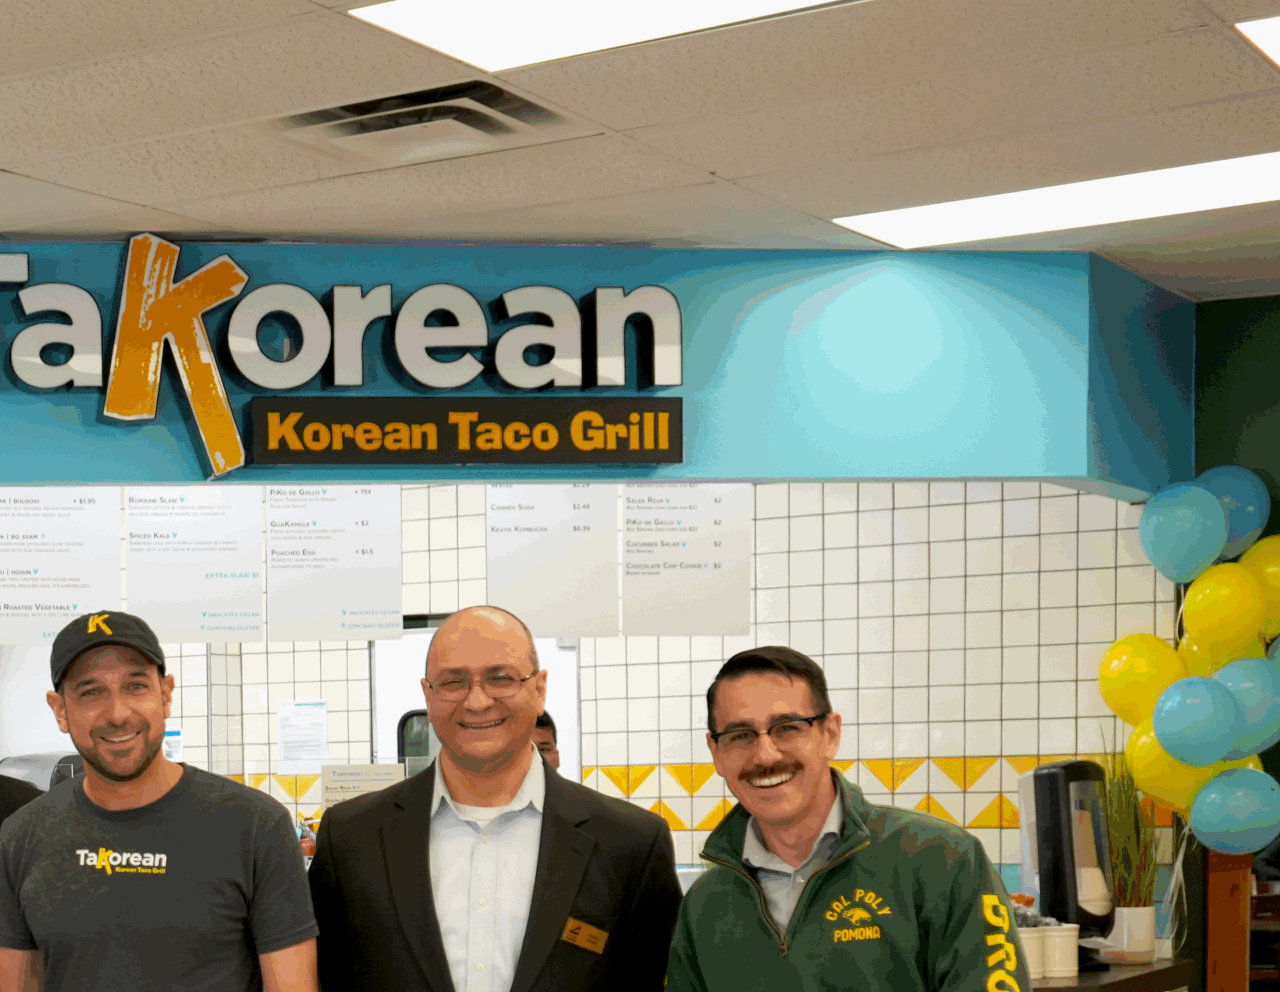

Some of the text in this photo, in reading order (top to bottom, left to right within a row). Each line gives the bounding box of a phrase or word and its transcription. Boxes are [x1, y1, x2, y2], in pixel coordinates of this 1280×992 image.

[267, 411, 669, 451] Korean Taco Grill
[88, 614, 113, 635] K
[76, 847, 167, 875] TaKorean
[825, 889, 892, 921] CAL POLY
[834, 927, 881, 942] POMONA
